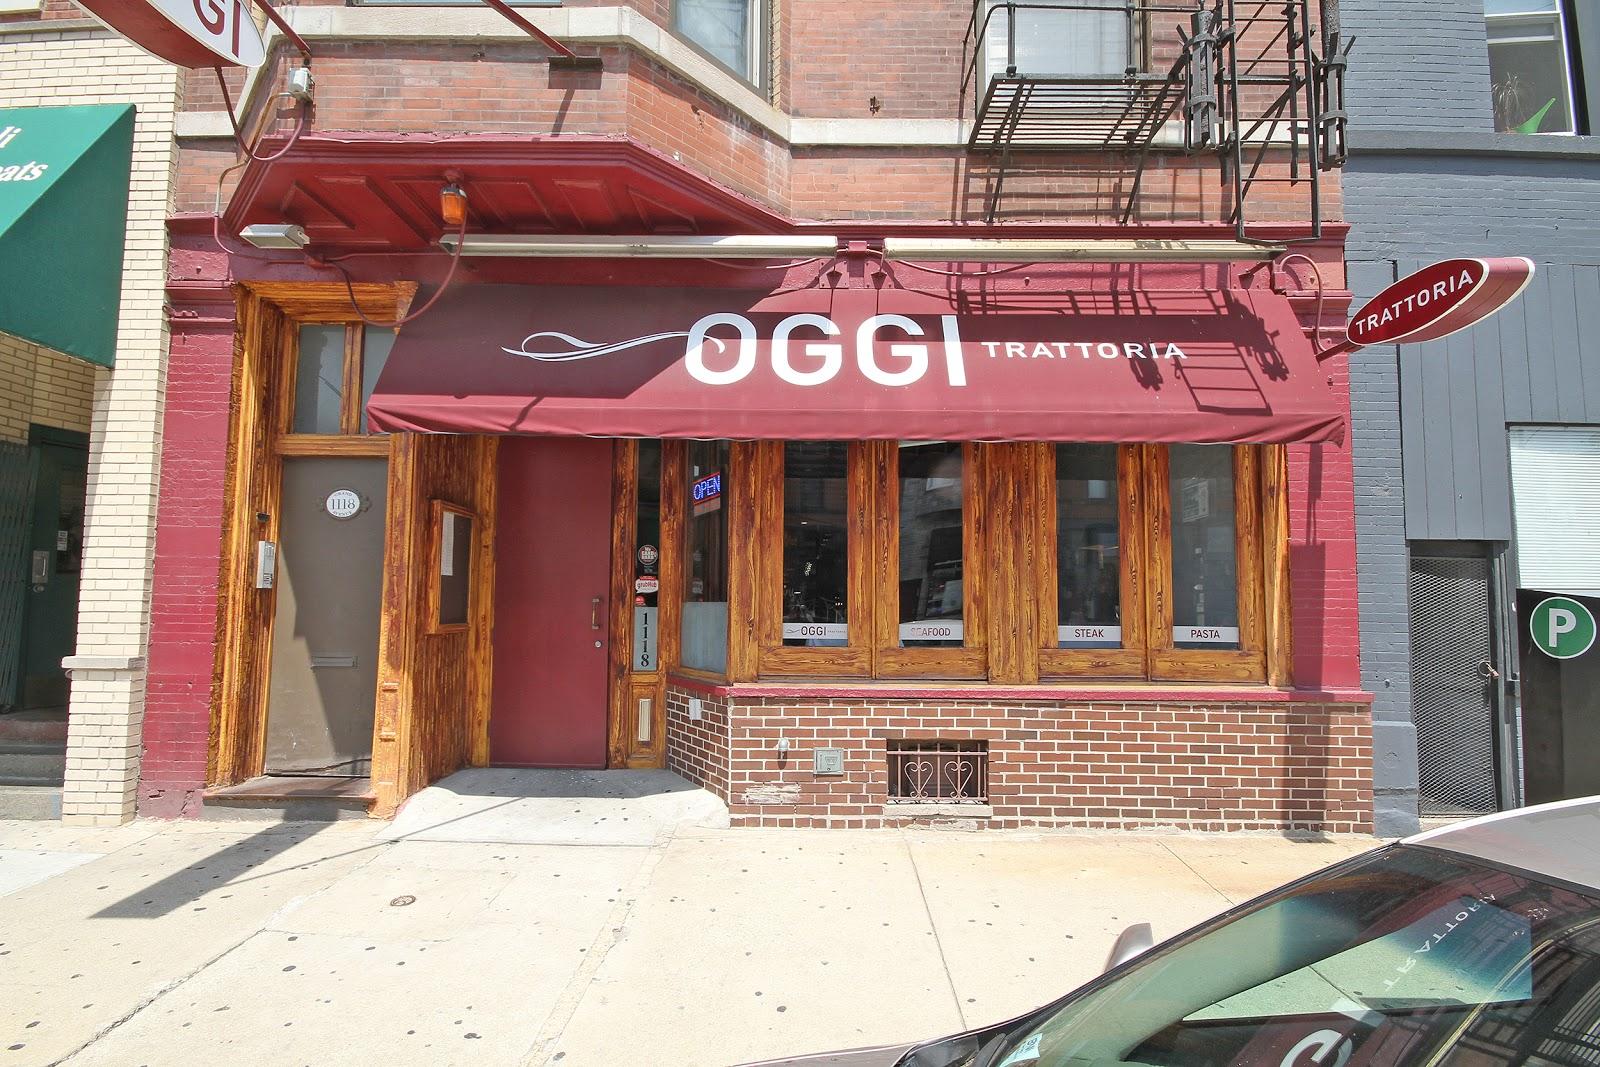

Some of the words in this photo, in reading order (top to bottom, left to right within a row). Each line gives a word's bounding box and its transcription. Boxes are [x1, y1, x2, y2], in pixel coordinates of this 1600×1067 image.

[0, 161, 49, 181] ats
[1355, 269, 1473, 335] TRATTORIA
[685, 312, 967, 387] OGGI
[980, 341, 1188, 359] TRATTORIA
[693, 475, 721, 500] OPEN
[331, 498, 355, 509] 1118
[801, 626, 827, 636] OGGI
[910, 627, 951, 637] SEAFOOD
[1074, 629, 1104, 638] STEAK
[1190, 629, 1220, 639] PASTA
[1548, 608, 1577, 648] P
[641, 612, 649, 667] 1118
